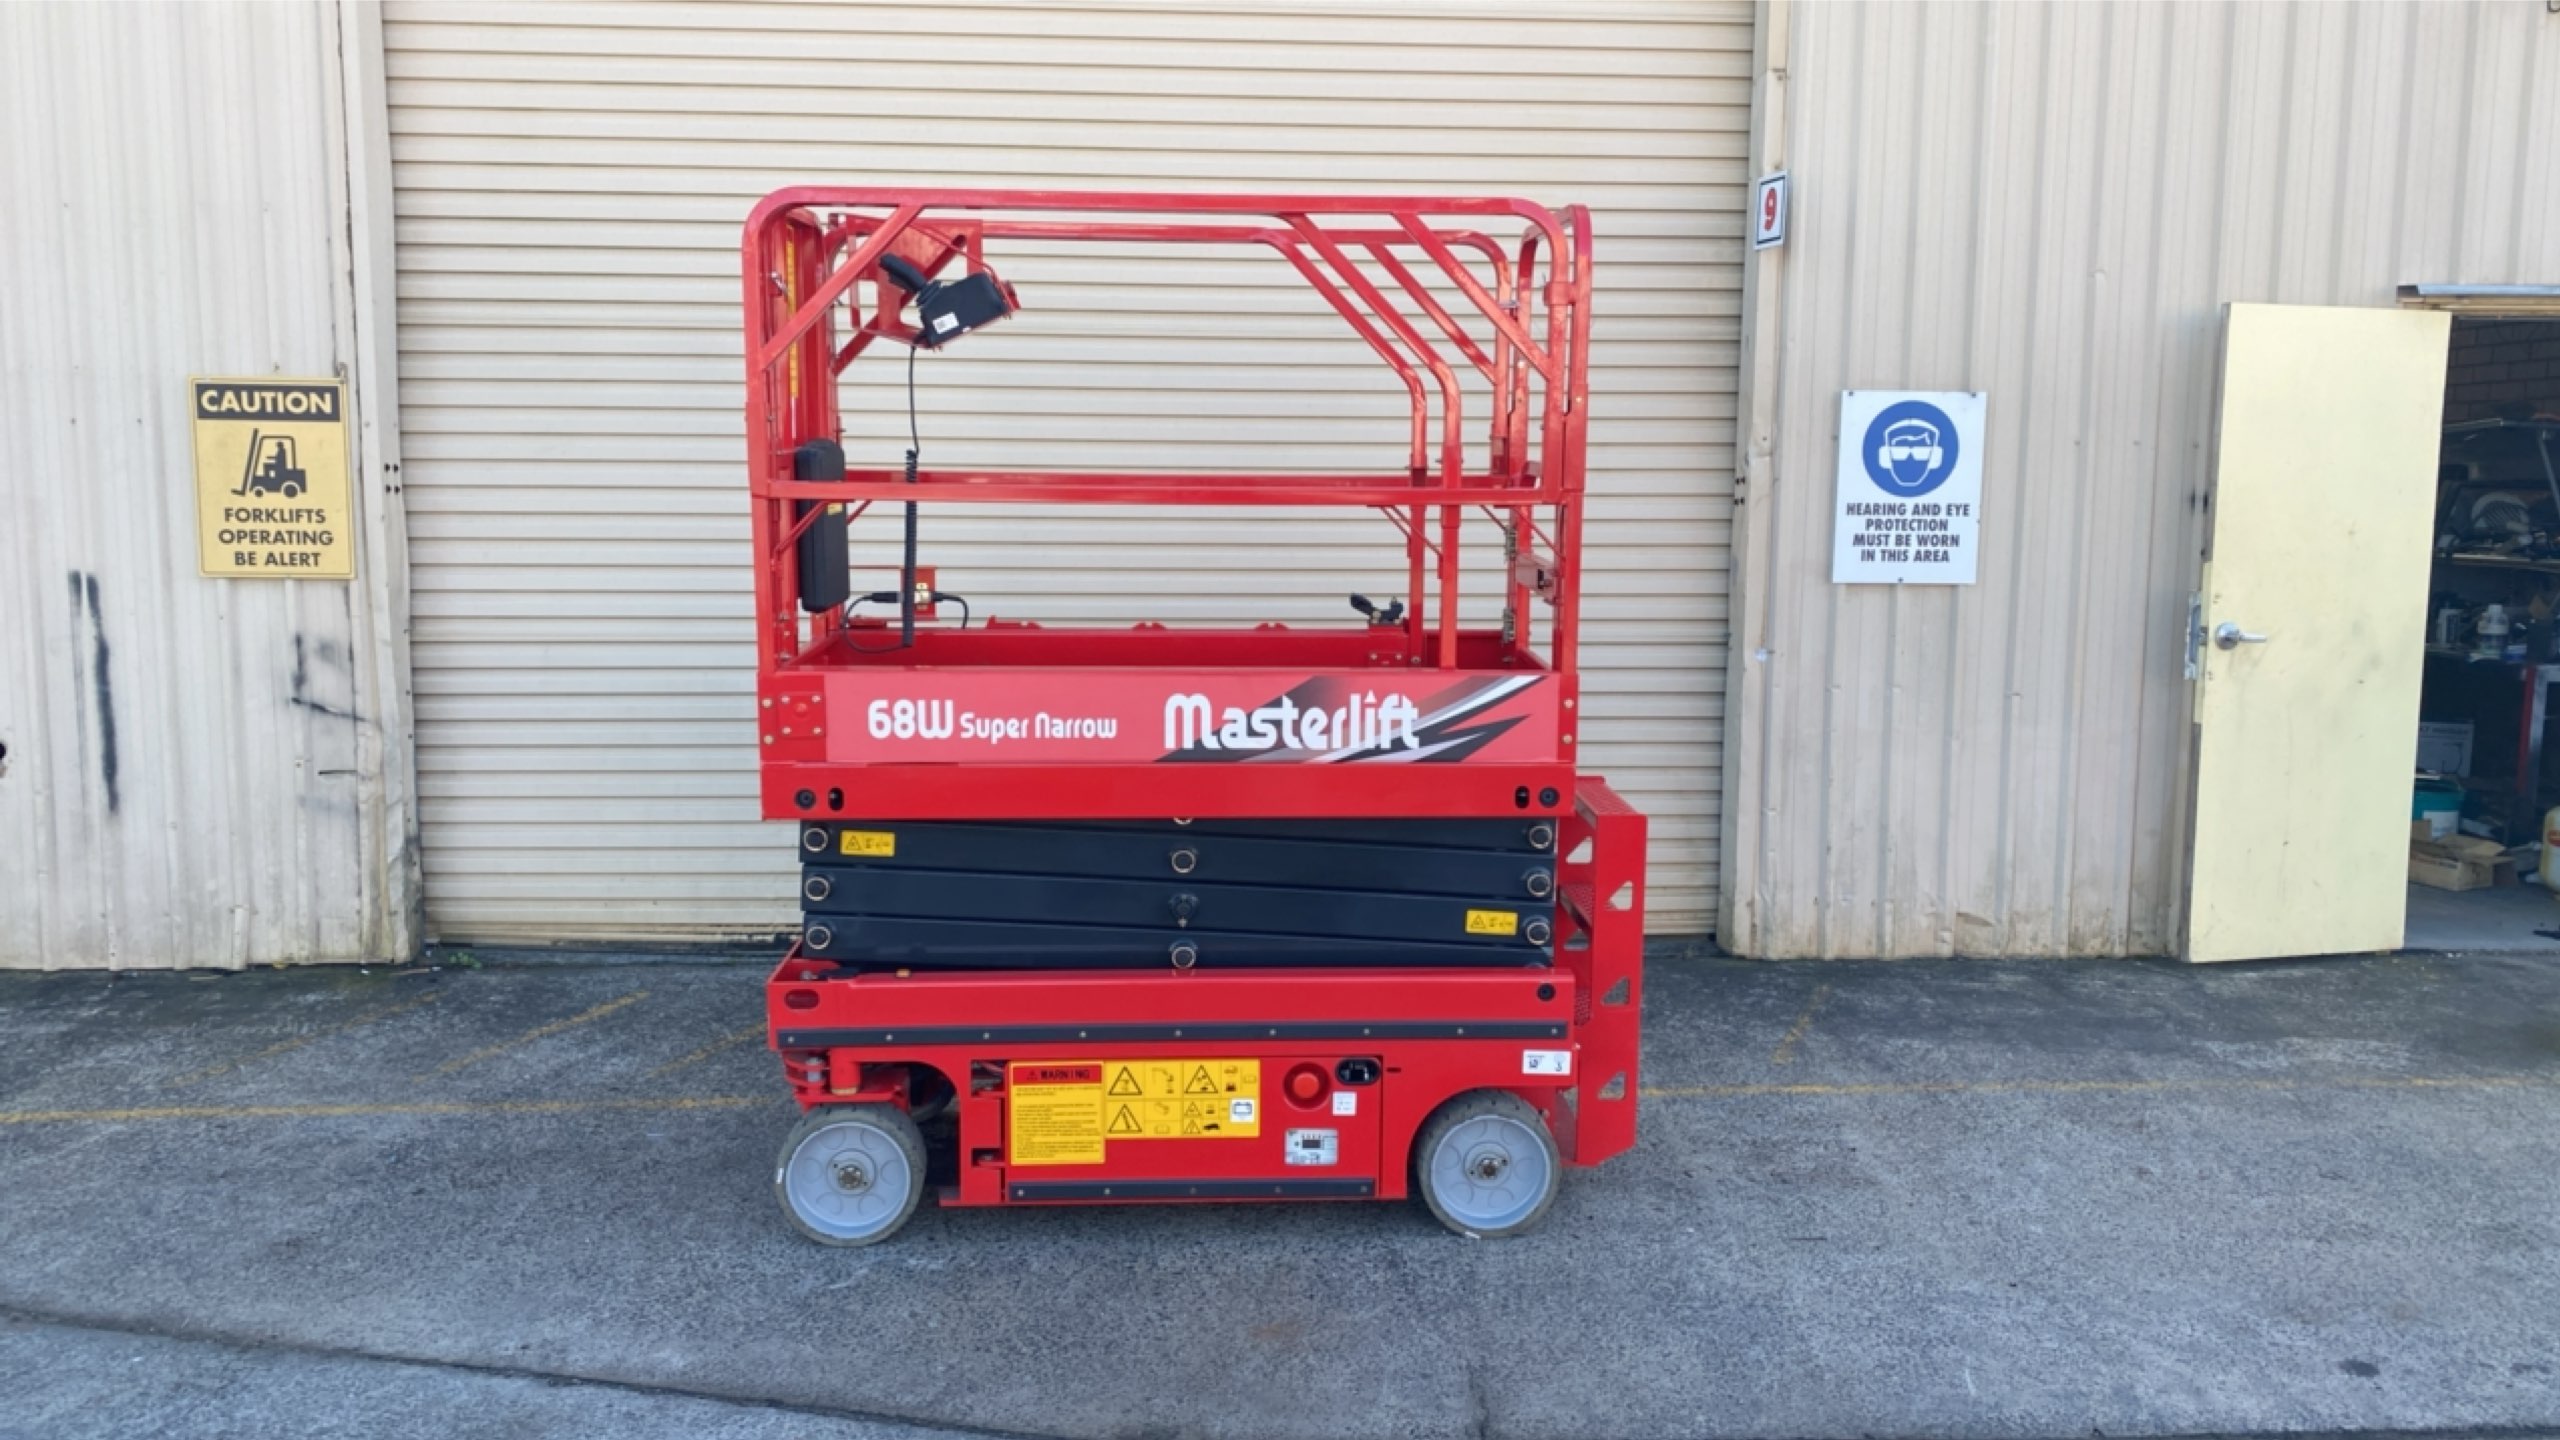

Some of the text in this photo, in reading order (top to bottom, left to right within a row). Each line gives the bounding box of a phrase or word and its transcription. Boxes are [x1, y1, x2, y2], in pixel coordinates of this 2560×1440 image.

[200, 389, 333, 415] CAUTION
[224, 507, 326, 524] FORKLIFTS
[1846, 502, 1971, 517] HEARING AND EYE
[1865, 518, 1949, 532] PROTECTION
[218, 529, 334, 546] OPERATING
[1852, 534, 1960, 548] MUST BE WORN
[234, 551, 321, 568] BE ALERT
[1861, 549, 1950, 563] IN THIS AREA
[867, 698, 1118, 745] 68W Super Narrow
[1164, 689, 1420, 750] Masterlift
[1040, 1068, 1090, 1080] WARNING
